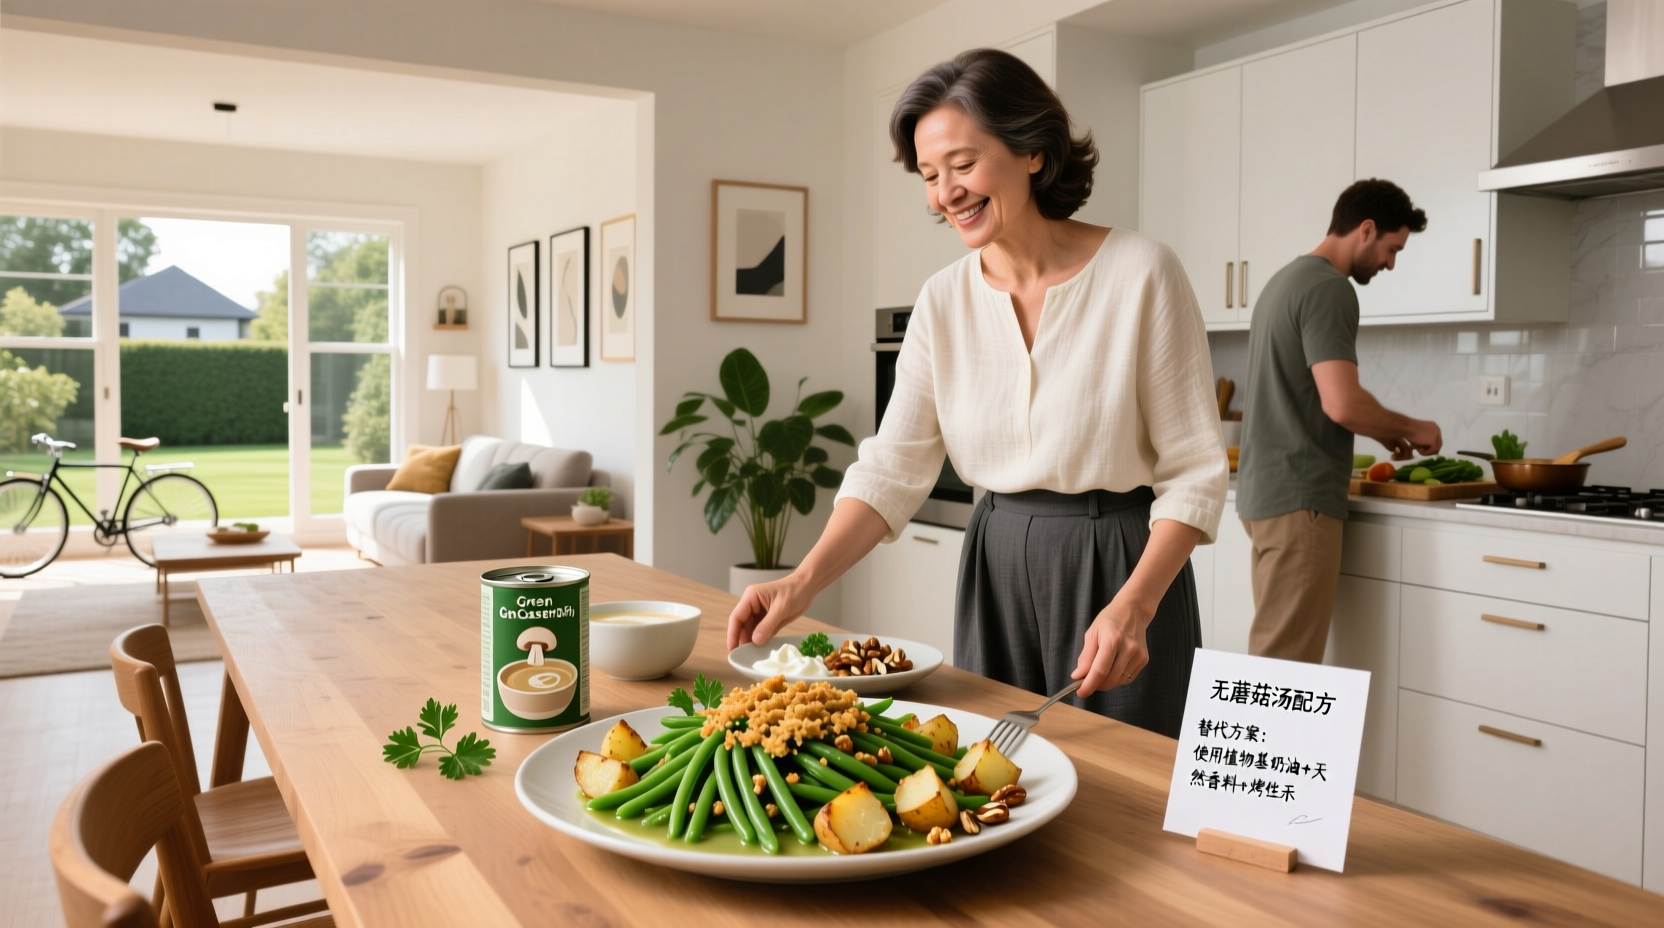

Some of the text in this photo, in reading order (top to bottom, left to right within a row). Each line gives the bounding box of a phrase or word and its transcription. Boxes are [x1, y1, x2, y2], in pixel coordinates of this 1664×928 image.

[1210, 679, 1337, 715] 无蘑菇汤配方
